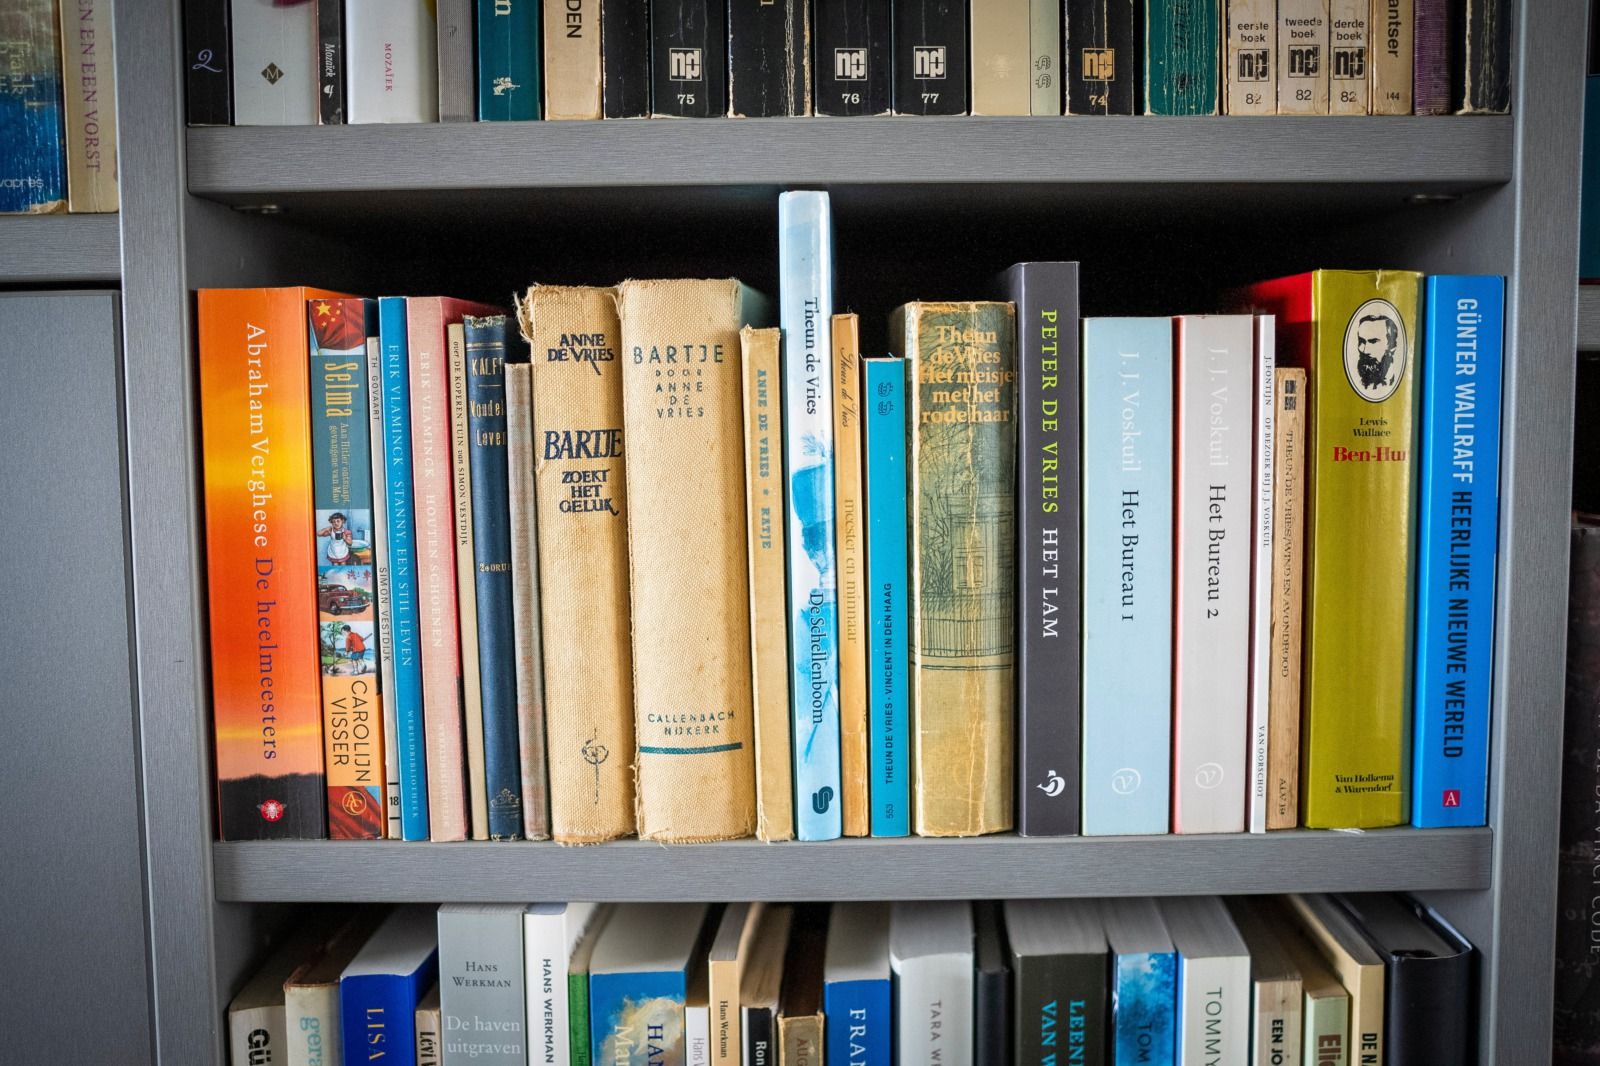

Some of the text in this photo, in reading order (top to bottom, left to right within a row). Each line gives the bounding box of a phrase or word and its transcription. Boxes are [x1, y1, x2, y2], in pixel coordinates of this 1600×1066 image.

[1285, 17, 1322, 27] tweede
[1291, 29, 1315, 38] boek
[1334, 19, 1365, 29] derde
[1241, 33, 1266, 42] boek
[1336, 31, 1362, 41] boek
[384, 43, 394, 92] MOZAÏEK
[80, 29, 100, 169] EN EEN VORST
[677, 94, 695, 104] 75
[842, 94, 860, 104] 76
[921, 93, 939, 103] 77
[1089, 95, 1107, 105] 74
[1246, 93, 1262, 104] 82
[1296, 89, 1311, 100] 82
[1340, 91, 1357, 102] 82
[560, 333, 606, 347] ANNE
[935, 325, 997, 343] Theun
[547, 348, 614, 376] DE VRIES
[634, 344, 724, 364] BARTJE
[930, 346, 1001, 364] de Vries
[455, 360, 461, 373] DE
[655, 369, 702, 377] DOOR
[957, 367, 1014, 386] meisje
[325, 362, 359, 417] Selma
[371, 357, 380, 421] TH GOVAART
[455, 375, 464, 419] KOPEREN
[655, 382, 703, 392] ANNE
[757, 369, 768, 407] ANNE
[932, 386, 1001, 403] met het
[669, 395, 690, 405] DE
[656, 408, 705, 418] VRIES
[758, 414, 768, 431] DE
[922, 405, 1009, 423] rode haar
[1359, 417, 1388, 426] Lewis
[456, 423, 464, 447] TUIN
[1122, 390, 1142, 471] Voskuil
[1210, 386, 1229, 466] Voskuil
[1353, 428, 1391, 438] Wallace
[544, 429, 622, 460] BARTJE
[759, 437, 770, 478] VRIES
[561, 468, 611, 484] ZOEKT
[1042, 309, 1059, 638] PETER DE VRIES HET LAM
[420, 352, 443, 648] ERIK VLAMINCK HOUTEN SCHOENEN
[571, 485, 602, 498] HET
[1209, 484, 1226, 523] Het
[388, 345, 412, 666] ERIK VLAMINCK EEN STIL LEVEN
[559, 498, 619, 516] GELUK
[805, 297, 829, 724] Theun de Vries De Schellenboom
[1122, 490, 1139, 528] Het
[460, 503, 468, 546] VESTDIJK
[1443, 298, 1482, 758] GÜNTER WALLRAFF HEERLIJKE NIEUWE WERELD
[247, 323, 278, 760] Abraham Verghese De heelmeesters
[845, 499, 860, 644] meester en minnaar
[1122, 534, 1139, 607] Bureau
[1208, 528, 1226, 602] Bureau
[379, 567, 391, 662] SIMON VESTDIJK
[1207, 608, 1219, 619] 2
[884, 583, 894, 819] 553 THEUN DE VRIES VINCENT IN DEN HAAG
[648, 710, 735, 724] CALLENBACH
[331, 697, 350, 766] VISSER
[351, 680, 371, 782] CAROLIJN
[1257, 747, 1265, 798] OORSCHOT
[1335, 773, 1395, 783] Van Holkema
[1344, 783, 1393, 793] Warendorf
[389, 796, 399, 806] 18
[447, 1016, 521, 1031] De haven
[543, 959, 555, 1064] HANS WERKMAN
[930, 1000, 942, 1042] TARA
[367, 1008, 385, 1060] LISA
[720, 1000, 729, 1058] Hans Werkman
[1041, 1001, 1057, 1047] VAN
[1206, 987, 1222, 1066] TOMMY
[1271, 1019, 1283, 1043] EEN
[447, 1039, 521, 1057] uitgraven
[693, 1037, 705, 1062] Hans
[756, 1041, 767, 1066] Ron
[1137, 1024, 1152, 1063] TOM
[1362, 1033, 1377, 1050] DE
